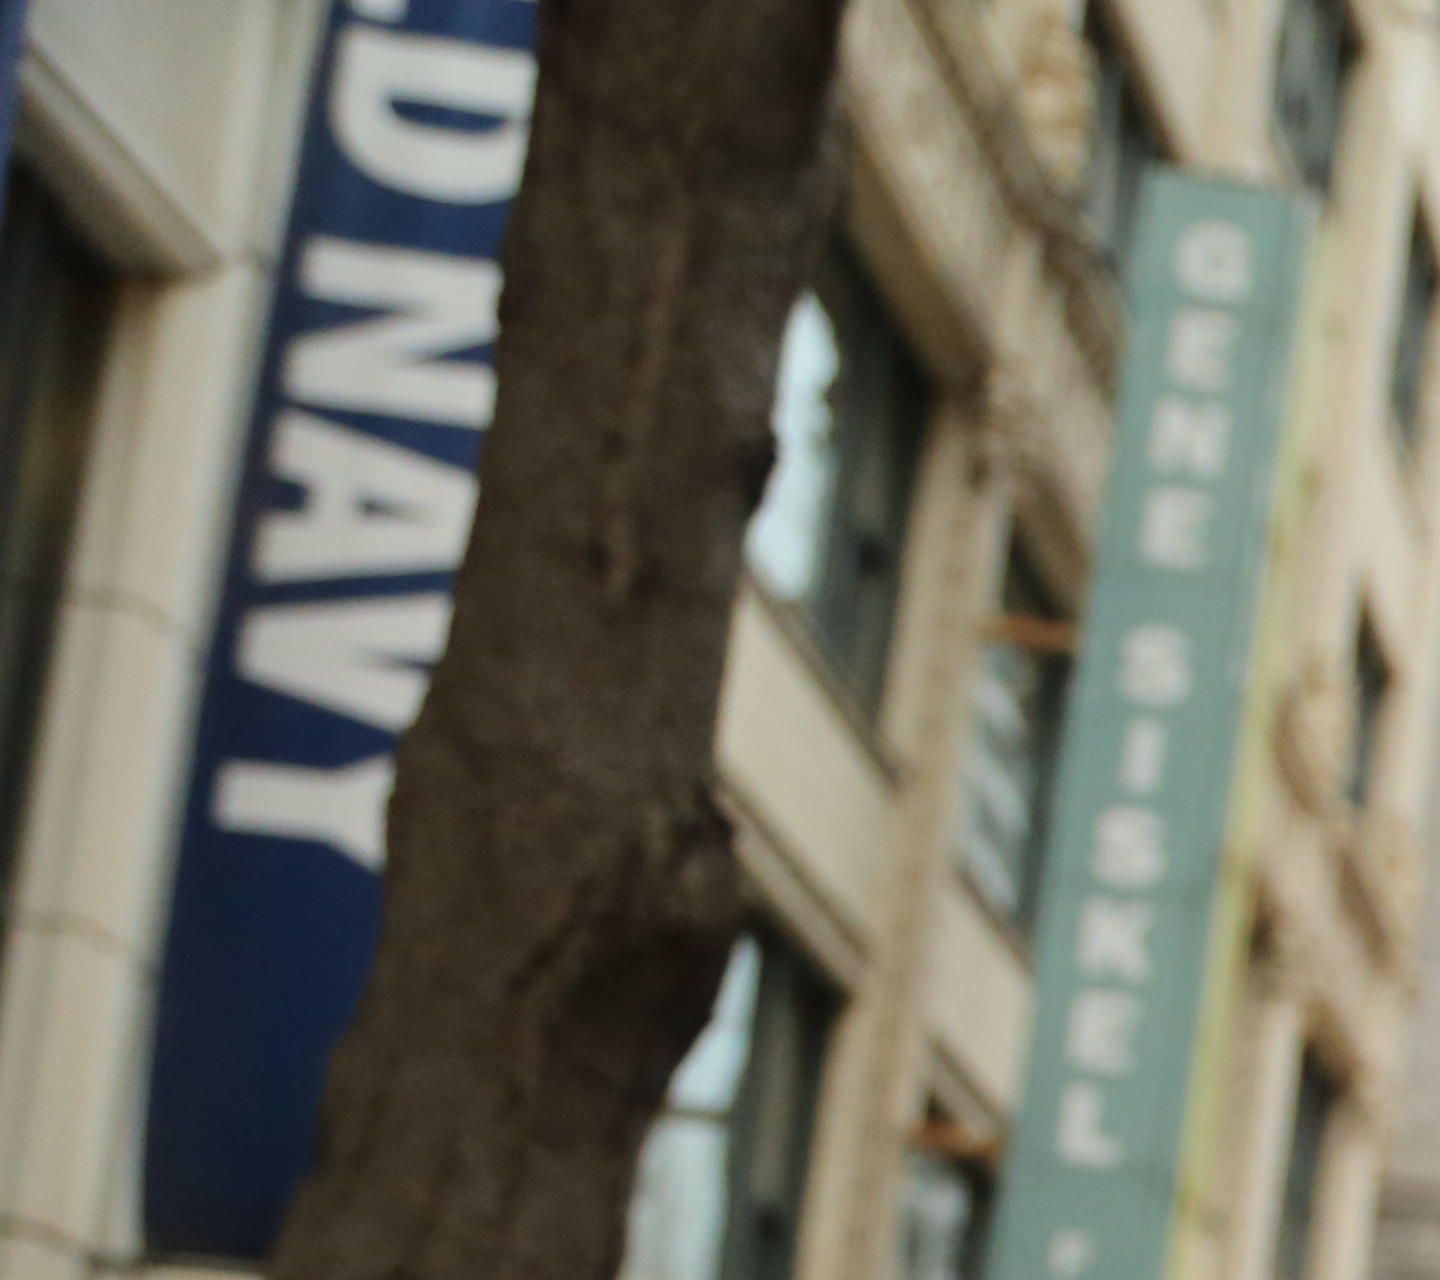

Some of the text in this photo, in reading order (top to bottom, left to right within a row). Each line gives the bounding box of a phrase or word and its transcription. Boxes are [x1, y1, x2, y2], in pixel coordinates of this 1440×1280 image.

[210, 235, 505, 873] NAVY
[1137, 216, 1253, 574] GENE
[1056, 622, 1194, 1170] SISKEL
